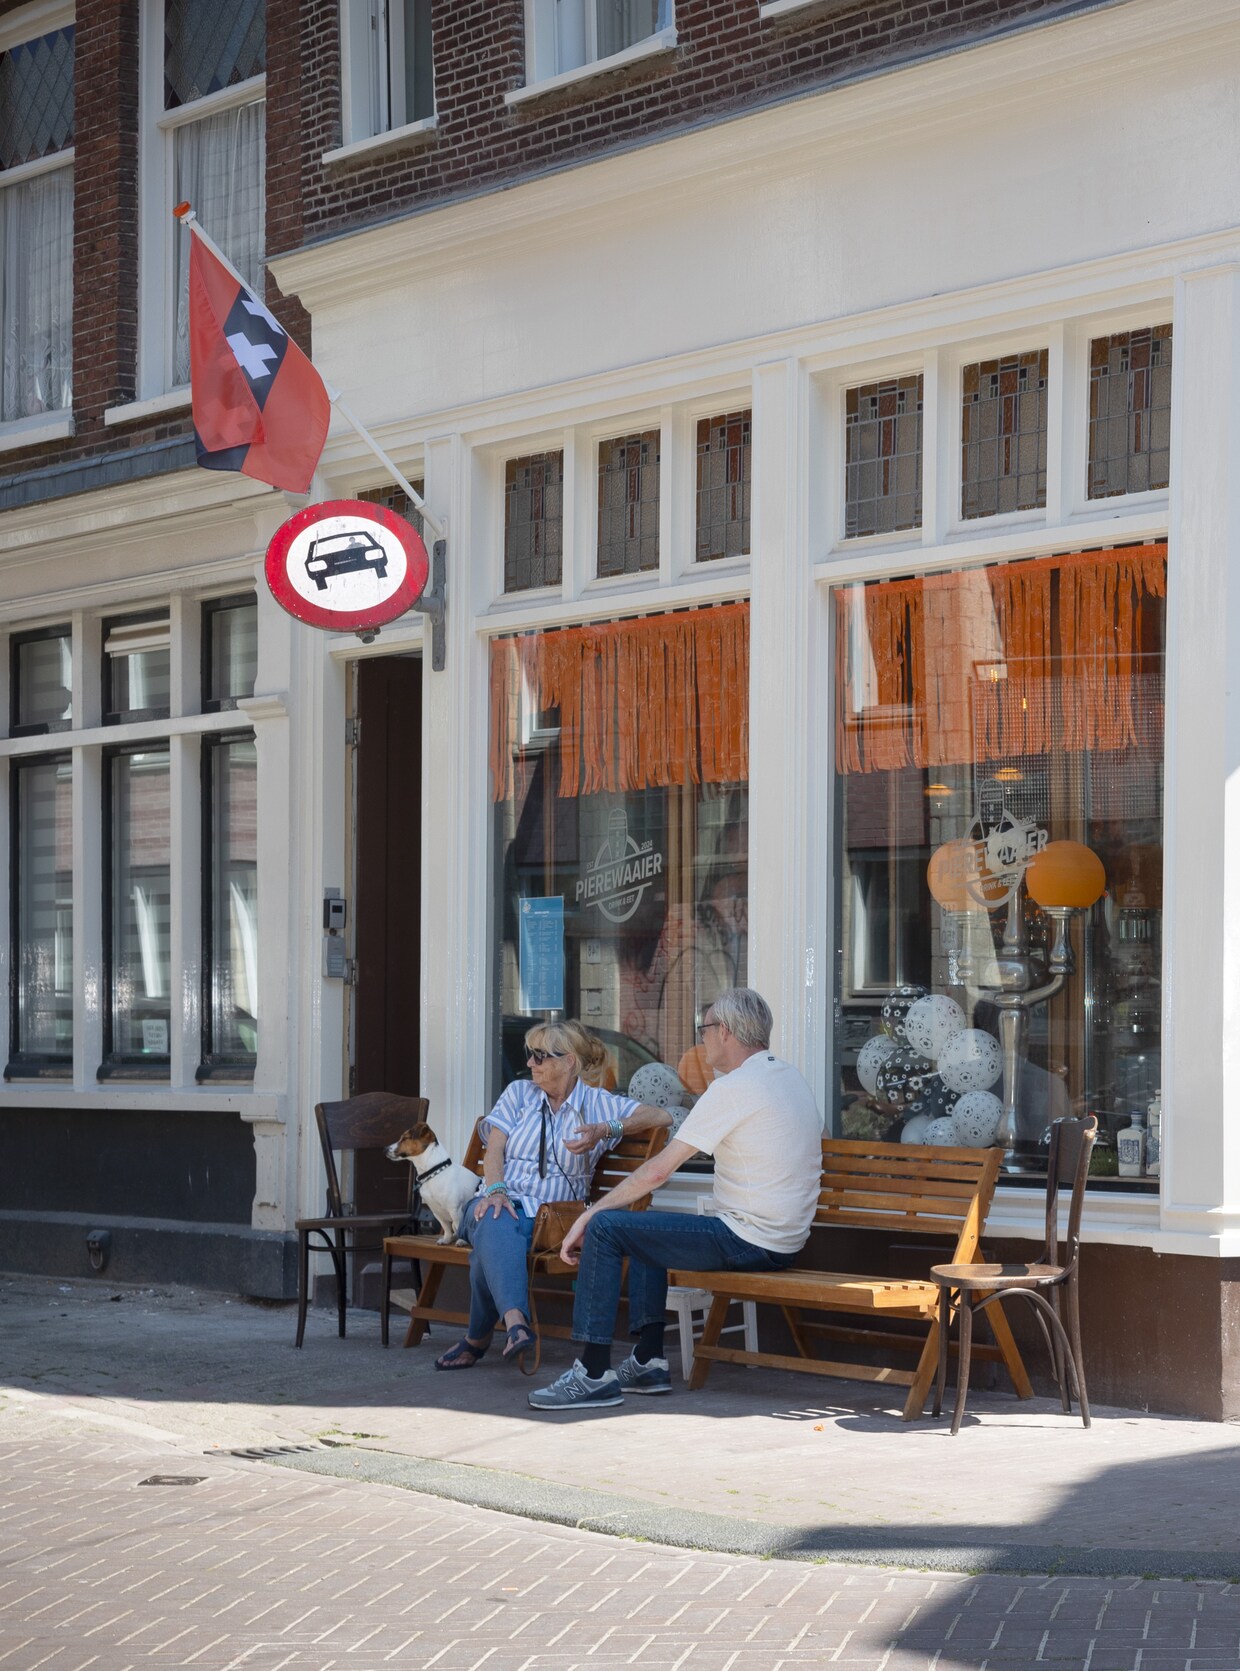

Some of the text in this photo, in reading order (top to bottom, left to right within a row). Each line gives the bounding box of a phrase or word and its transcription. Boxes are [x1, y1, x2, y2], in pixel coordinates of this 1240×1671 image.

[641, 840, 653, 850] 2024
[575, 852, 662, 902] PIEREWAAIER
[563, 1381, 586, 1400] N
